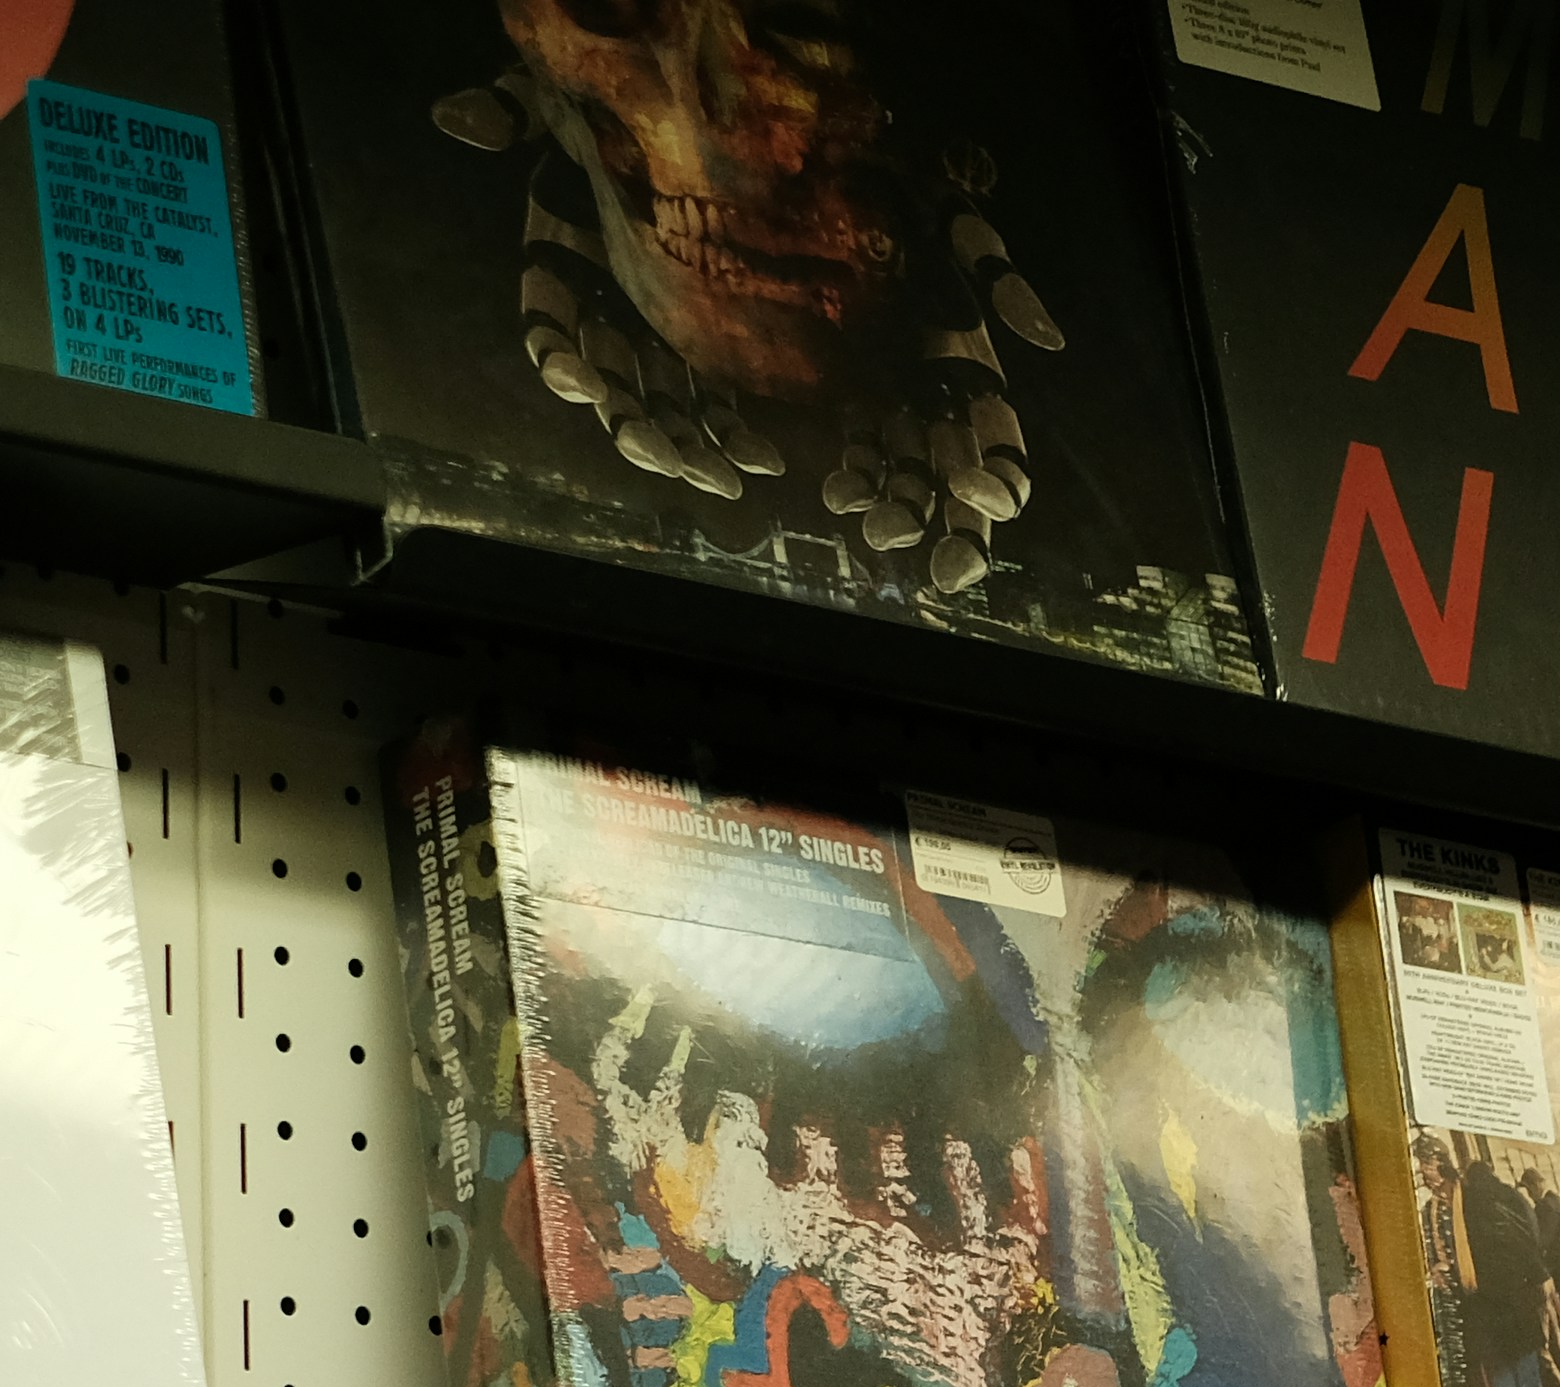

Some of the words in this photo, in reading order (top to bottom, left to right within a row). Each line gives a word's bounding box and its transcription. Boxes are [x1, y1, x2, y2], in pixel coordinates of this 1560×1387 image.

[39, 97, 121, 144] DELUXE
[127, 119, 210, 166] EDITION
[72, 161, 97, 182] DVD
[48, 182, 78, 203] LIVE
[83, 190, 118, 212] FROM
[123, 198, 148, 219] THE
[51, 202, 93, 229] SANTA
[139, 221, 156, 240] CA
[52, 223, 125, 253] NOVEMBER
[155, 246, 184, 267] 1990
[57, 252, 76, 277] 19
[63, 306, 87, 332] ON
[78, 282, 179, 326] BLISTERING
[66, 339, 99, 361] FIRST
[103, 345, 126, 365] LIVE
[131, 351, 218, 384] PERFORMANCES
[70, 359, 125, 386] RAGGED
[131, 368, 176, 394] GLORY
[617, 767, 701, 802] SCREAM
[412, 786, 433, 836] THE
[436, 775, 460, 869] PRIMAL
[583, 796, 754, 849] SCREAMADELICA
[800, 835, 885, 875] SINGLES
[764, 862, 810, 884] SINGLES
[1396, 838, 1437, 857] THE
[1441, 842, 1500, 875] KINKS
[843, 892, 891, 917] REMIXES
[418, 839, 457, 1043] SCREAMADELICA
[446, 876, 473, 976] SCREAM
[447, 1097, 474, 1203] SINGLES
